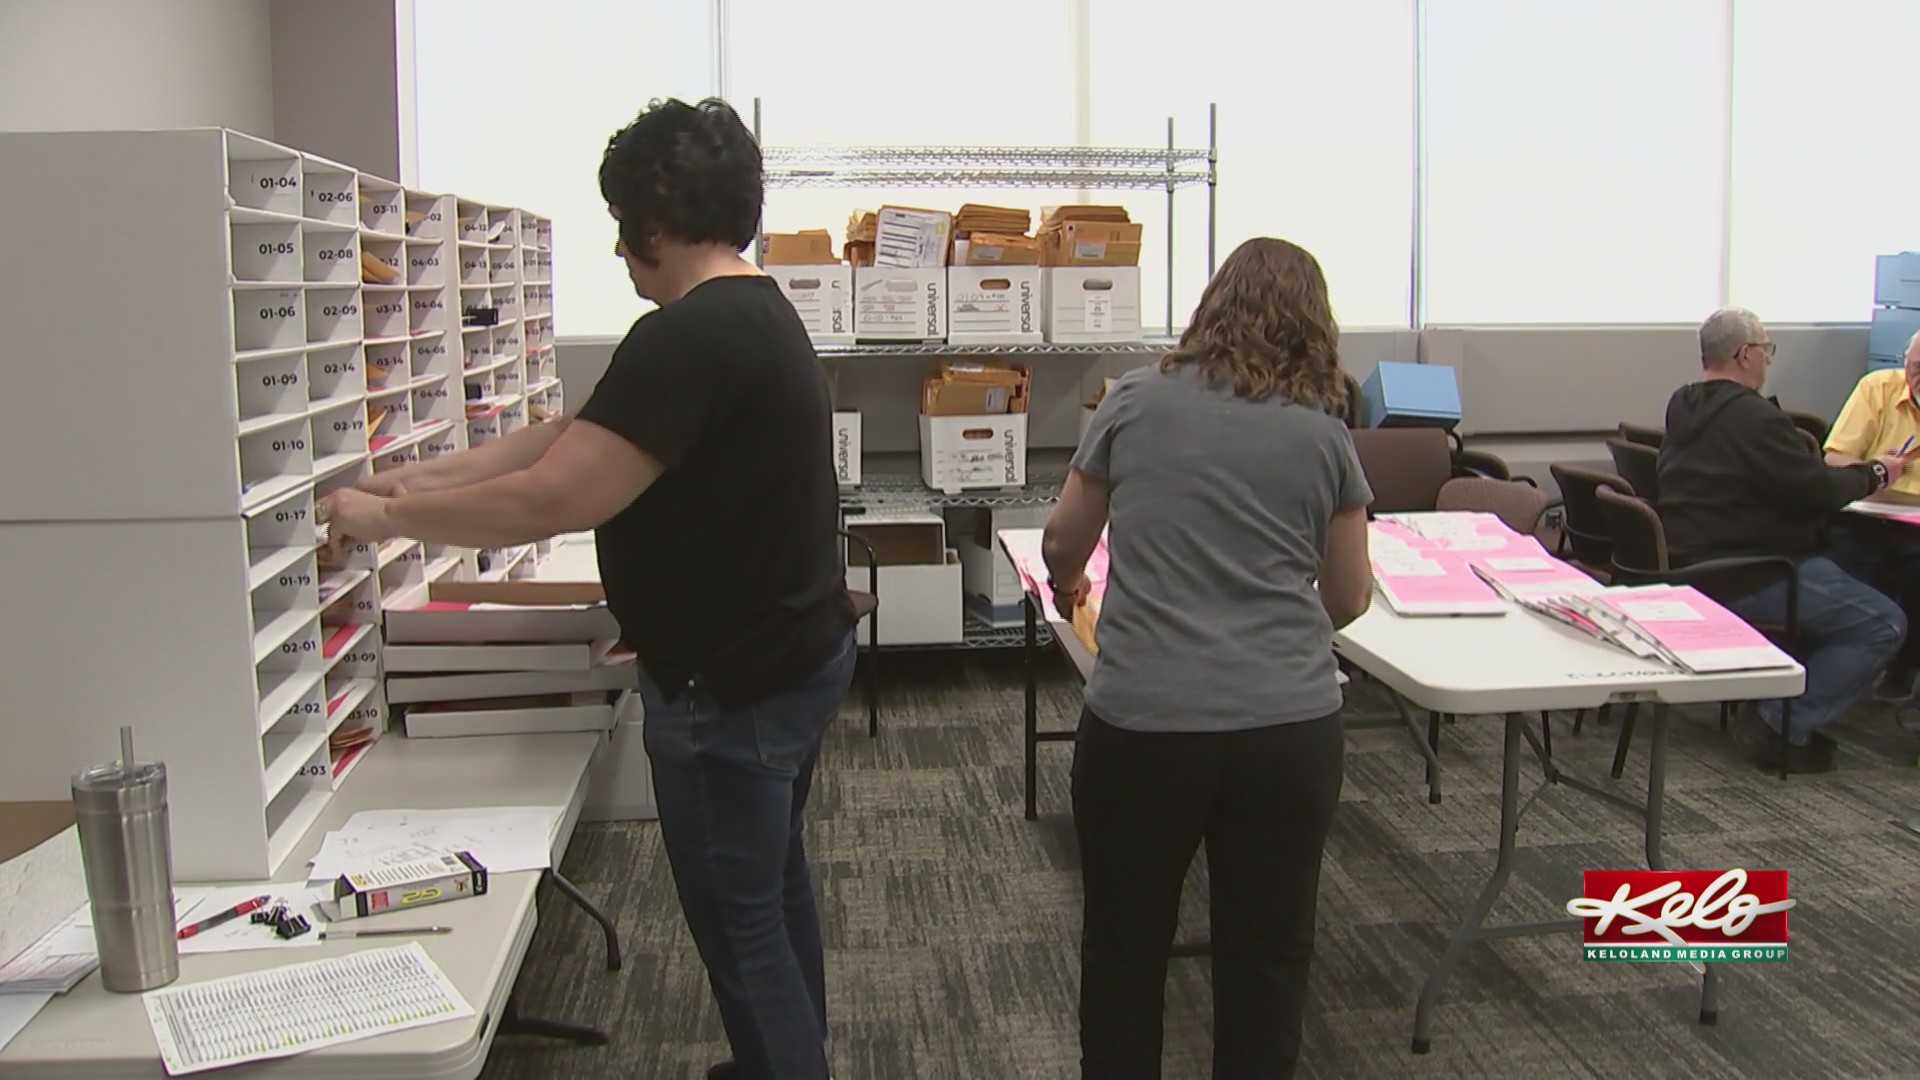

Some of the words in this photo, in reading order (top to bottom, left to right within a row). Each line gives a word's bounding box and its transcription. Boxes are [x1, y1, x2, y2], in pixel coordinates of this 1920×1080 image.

[260, 177, 297, 189] 01-04
[318, 192, 353, 203] 02-06
[373, 205, 398, 214] 03-11
[259, 243, 294, 255] 01-05
[319, 249, 353, 260] 02-08
[411, 258, 439, 266] 04-03
[323, 305, 358, 316] 02-09
[376, 304, 403, 314] 03-13
[414, 301, 443, 309] 04-04
[926, 282, 940, 337] universal
[1020, 281, 1034, 333] universal
[260, 306, 296, 319] 01-06
[376, 357, 404, 367] 03-14
[324, 363, 355, 374] 02-14
[262, 373, 298, 387] 01-09
[333, 421, 364, 431] 02-17
[272, 440, 305, 451] 01-10
[838, 428, 851, 482] universal
[1003, 429, 1018, 484] universal
[275, 510, 306, 521] 01-17
[280, 576, 311, 587] 01-19
[282, 640, 316, 653] 02-01
[343, 652, 376, 663] 03-09
[296, 765, 326, 776] 2-03
